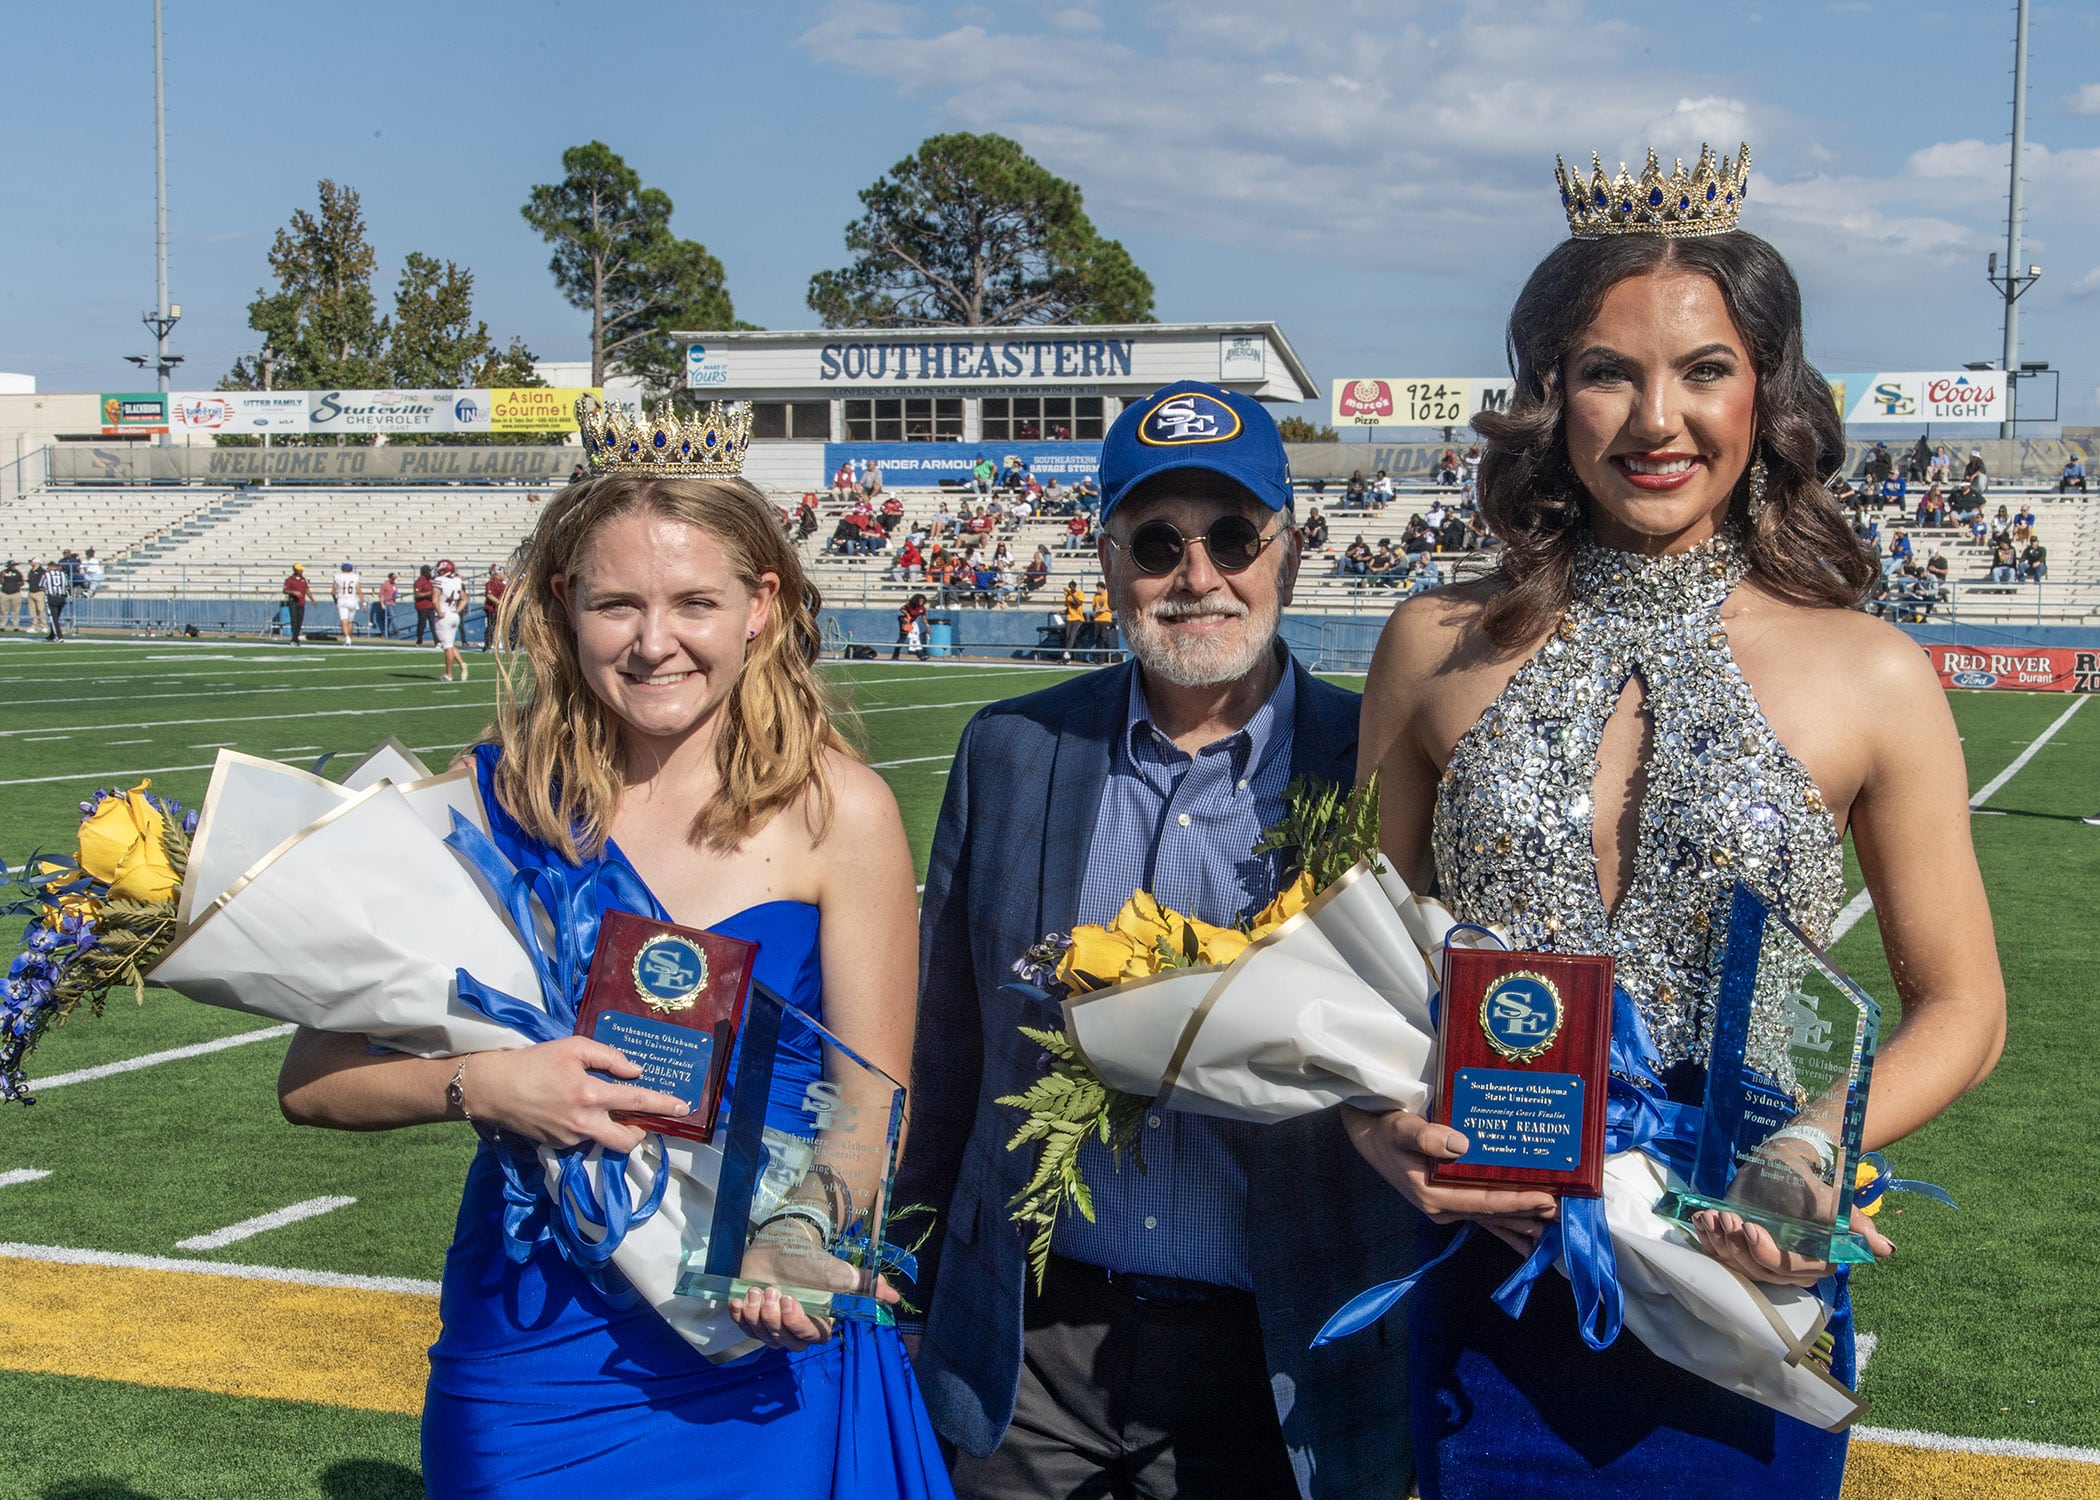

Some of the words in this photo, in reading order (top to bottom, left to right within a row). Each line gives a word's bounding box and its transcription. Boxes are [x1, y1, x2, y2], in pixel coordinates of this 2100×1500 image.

[820, 339, 1134, 380] SOUTHEASTERN
[689, 367, 728, 386] YOURS
[508, 391, 554, 403] Asian
[1406, 384, 1461, 400] 924-
[1928, 379, 1996, 403] Coors
[273, 399, 303, 407] FAMILY
[310, 392, 434, 423] Stuteville
[495, 404, 568, 416] Gourmet
[1410, 403, 1460, 420] 1020
[1935, 404, 1988, 416] LIGHT
[346, 415, 430, 424] CHEVROLET
[1157, 398, 1219, 439] SE
[1354, 415, 1380, 425] Pizza
[209, 451, 328, 474] WELCOME
[336, 451, 366, 473] TO
[400, 451, 462, 474] PAUL
[468, 451, 546, 474] LAIRD
[1029, 464, 1065, 472] SAVAGE
[1067, 464, 1100, 472] STORM
[1033, 456, 1097, 464] SOUTHEASTERN
[342, 581, 354, 595] 16
[1943, 652, 1986, 673] RED
[1989, 654, 2052, 676] RIVER
[1960, 672, 1988, 684] Ford
[2018, 673, 2053, 683] Durant
[645, 949, 694, 991] SE
[1493, 991, 1549, 1036] SE
[1780, 991, 1833, 1052] SE
[612, 1023, 660, 1040] Southeastern
[661, 1034, 699, 1050] Oklahoma
[623, 1035, 643, 1045] State
[645, 1040, 683, 1056] University
[648, 1053, 667, 1063] Court
[667, 1057, 694, 1070] Finalist
[642, 1062, 692, 1082] COBLENTZ
[1470, 1081, 1524, 1093] Southeastern
[1526, 1085, 1568, 1096] Oklahoma
[1484, 1092, 1506, 1102] State
[1509, 1094, 1553, 1106] University
[1744, 1090, 1787, 1111] Sydney
[1470, 1106, 1514, 1117] Homecoming
[1515, 1109, 1536, 1117] Court
[1537, 1110, 1566, 1119] Finalist
[1743, 1110, 1777, 1128] Women
[1463, 1117, 1508, 1131] SYDNEY
[1516, 1121, 1571, 1136] REARDON
[1482, 1144, 1517, 1153] November
